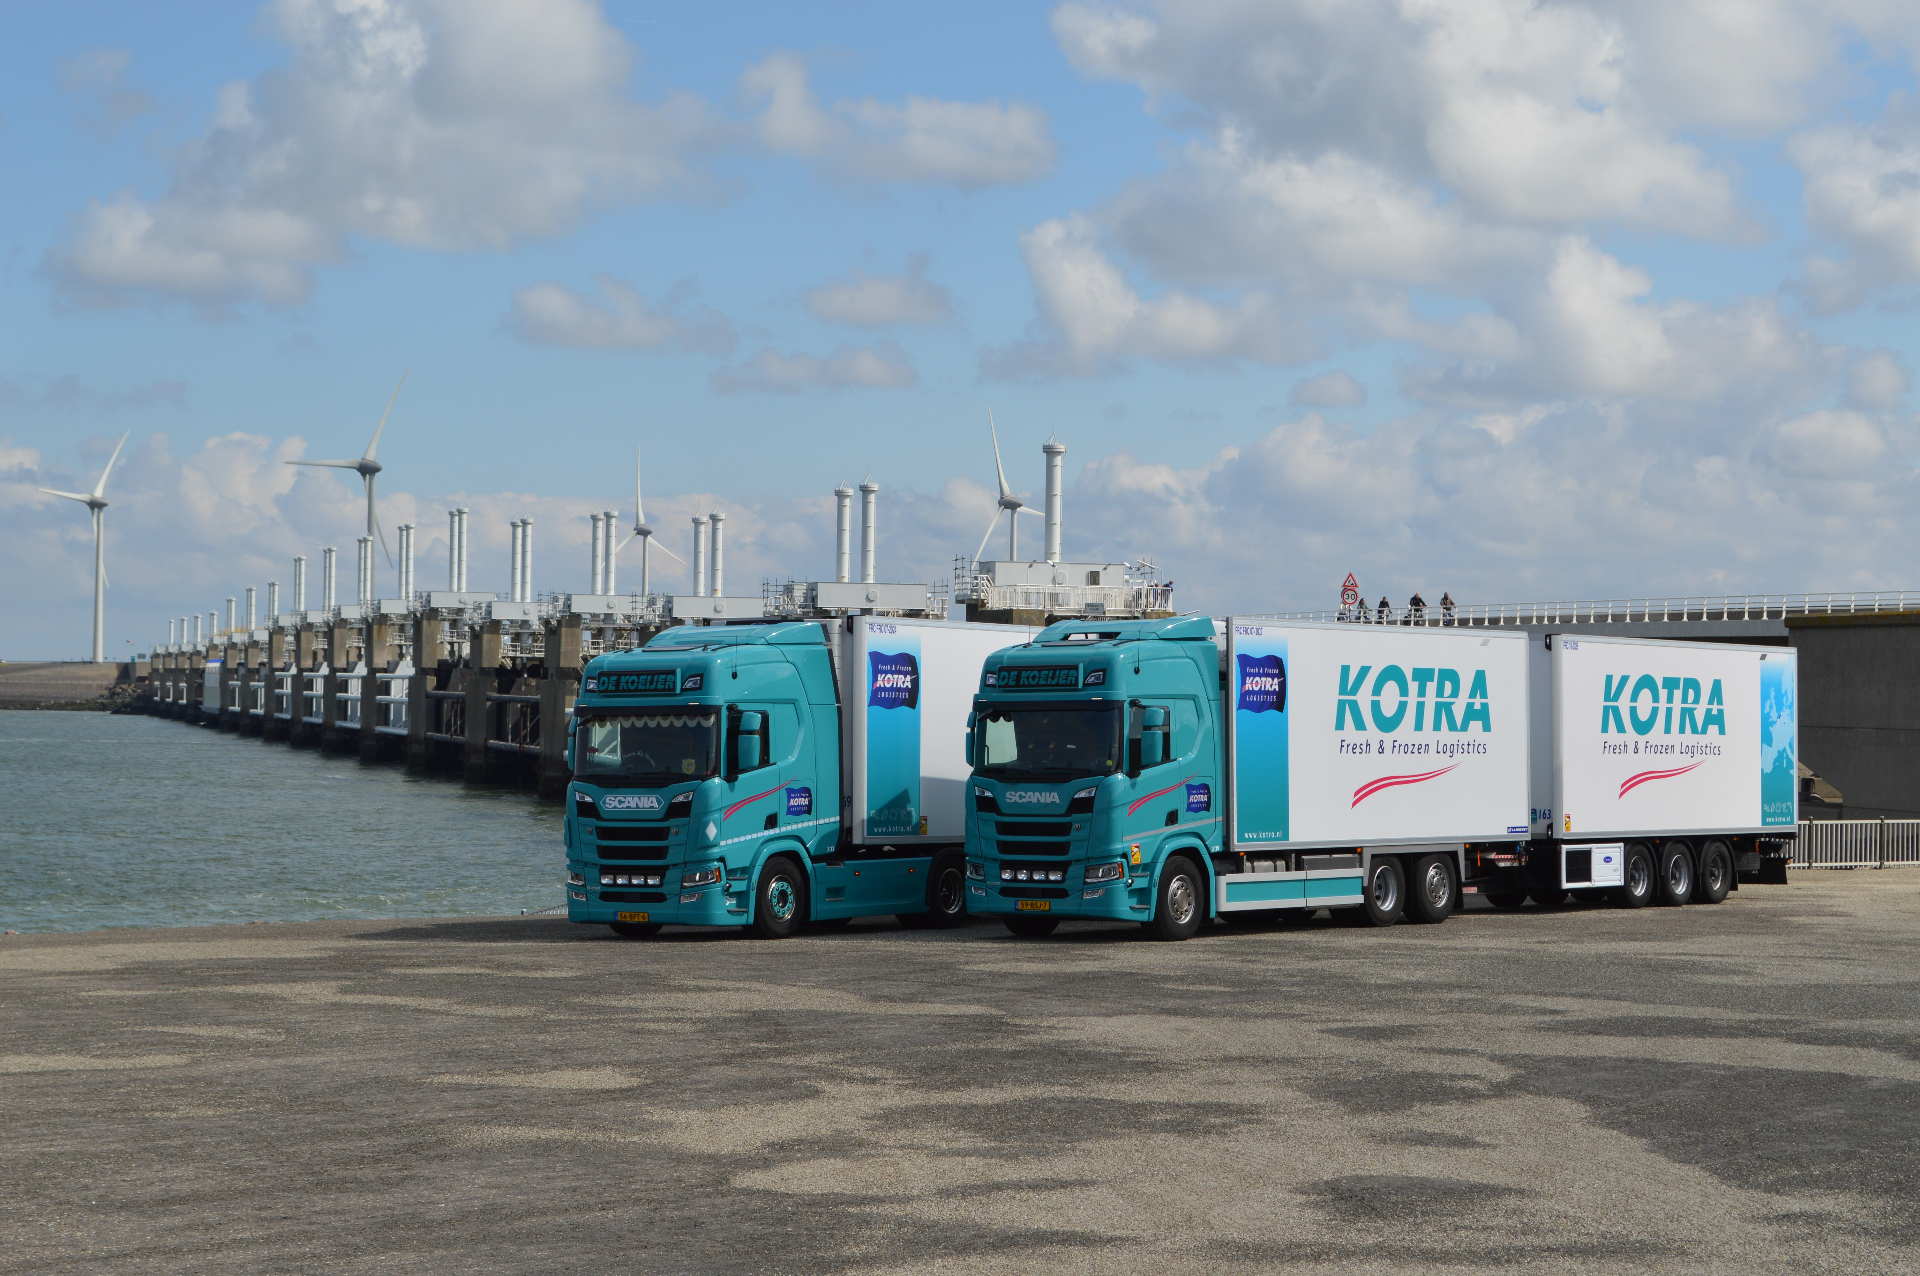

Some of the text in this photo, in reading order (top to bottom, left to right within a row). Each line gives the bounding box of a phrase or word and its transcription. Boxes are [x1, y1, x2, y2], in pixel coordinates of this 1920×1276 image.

[1345, 593, 1356, 601] 30
[1246, 666, 1258, 674] Fresh
[598, 674, 675, 691] DE KOEIJER
[876, 673, 912, 689] KOTRA
[999, 669, 1078, 686] DE KOEIJER
[1245, 676, 1279, 692] KOTRA
[877, 691, 909, 699] LOGISTICS
[1246, 694, 1277, 702] LOGISTICS
[1335, 664, 1492, 734] KOTRA
[1601, 673, 1726, 736] KOTRA
[1339, 738, 1487, 758] Fresh & Frozen Logistics
[1602, 740, 1721, 759] Fresh & Frozen Logistics
[605, 796, 659, 809] SCANIA
[789, 797, 809, 806] KOTRA
[1005, 791, 1060, 804] SCANIA
[1189, 794, 1208, 803] KOTRA
[1538, 808, 1552, 820] 163
[873, 825, 912, 833] www.kotra.nl
[1244, 830, 1283, 839] www.kotra.nl
[1020, 901, 1047, 909] 59-BSJ-7
